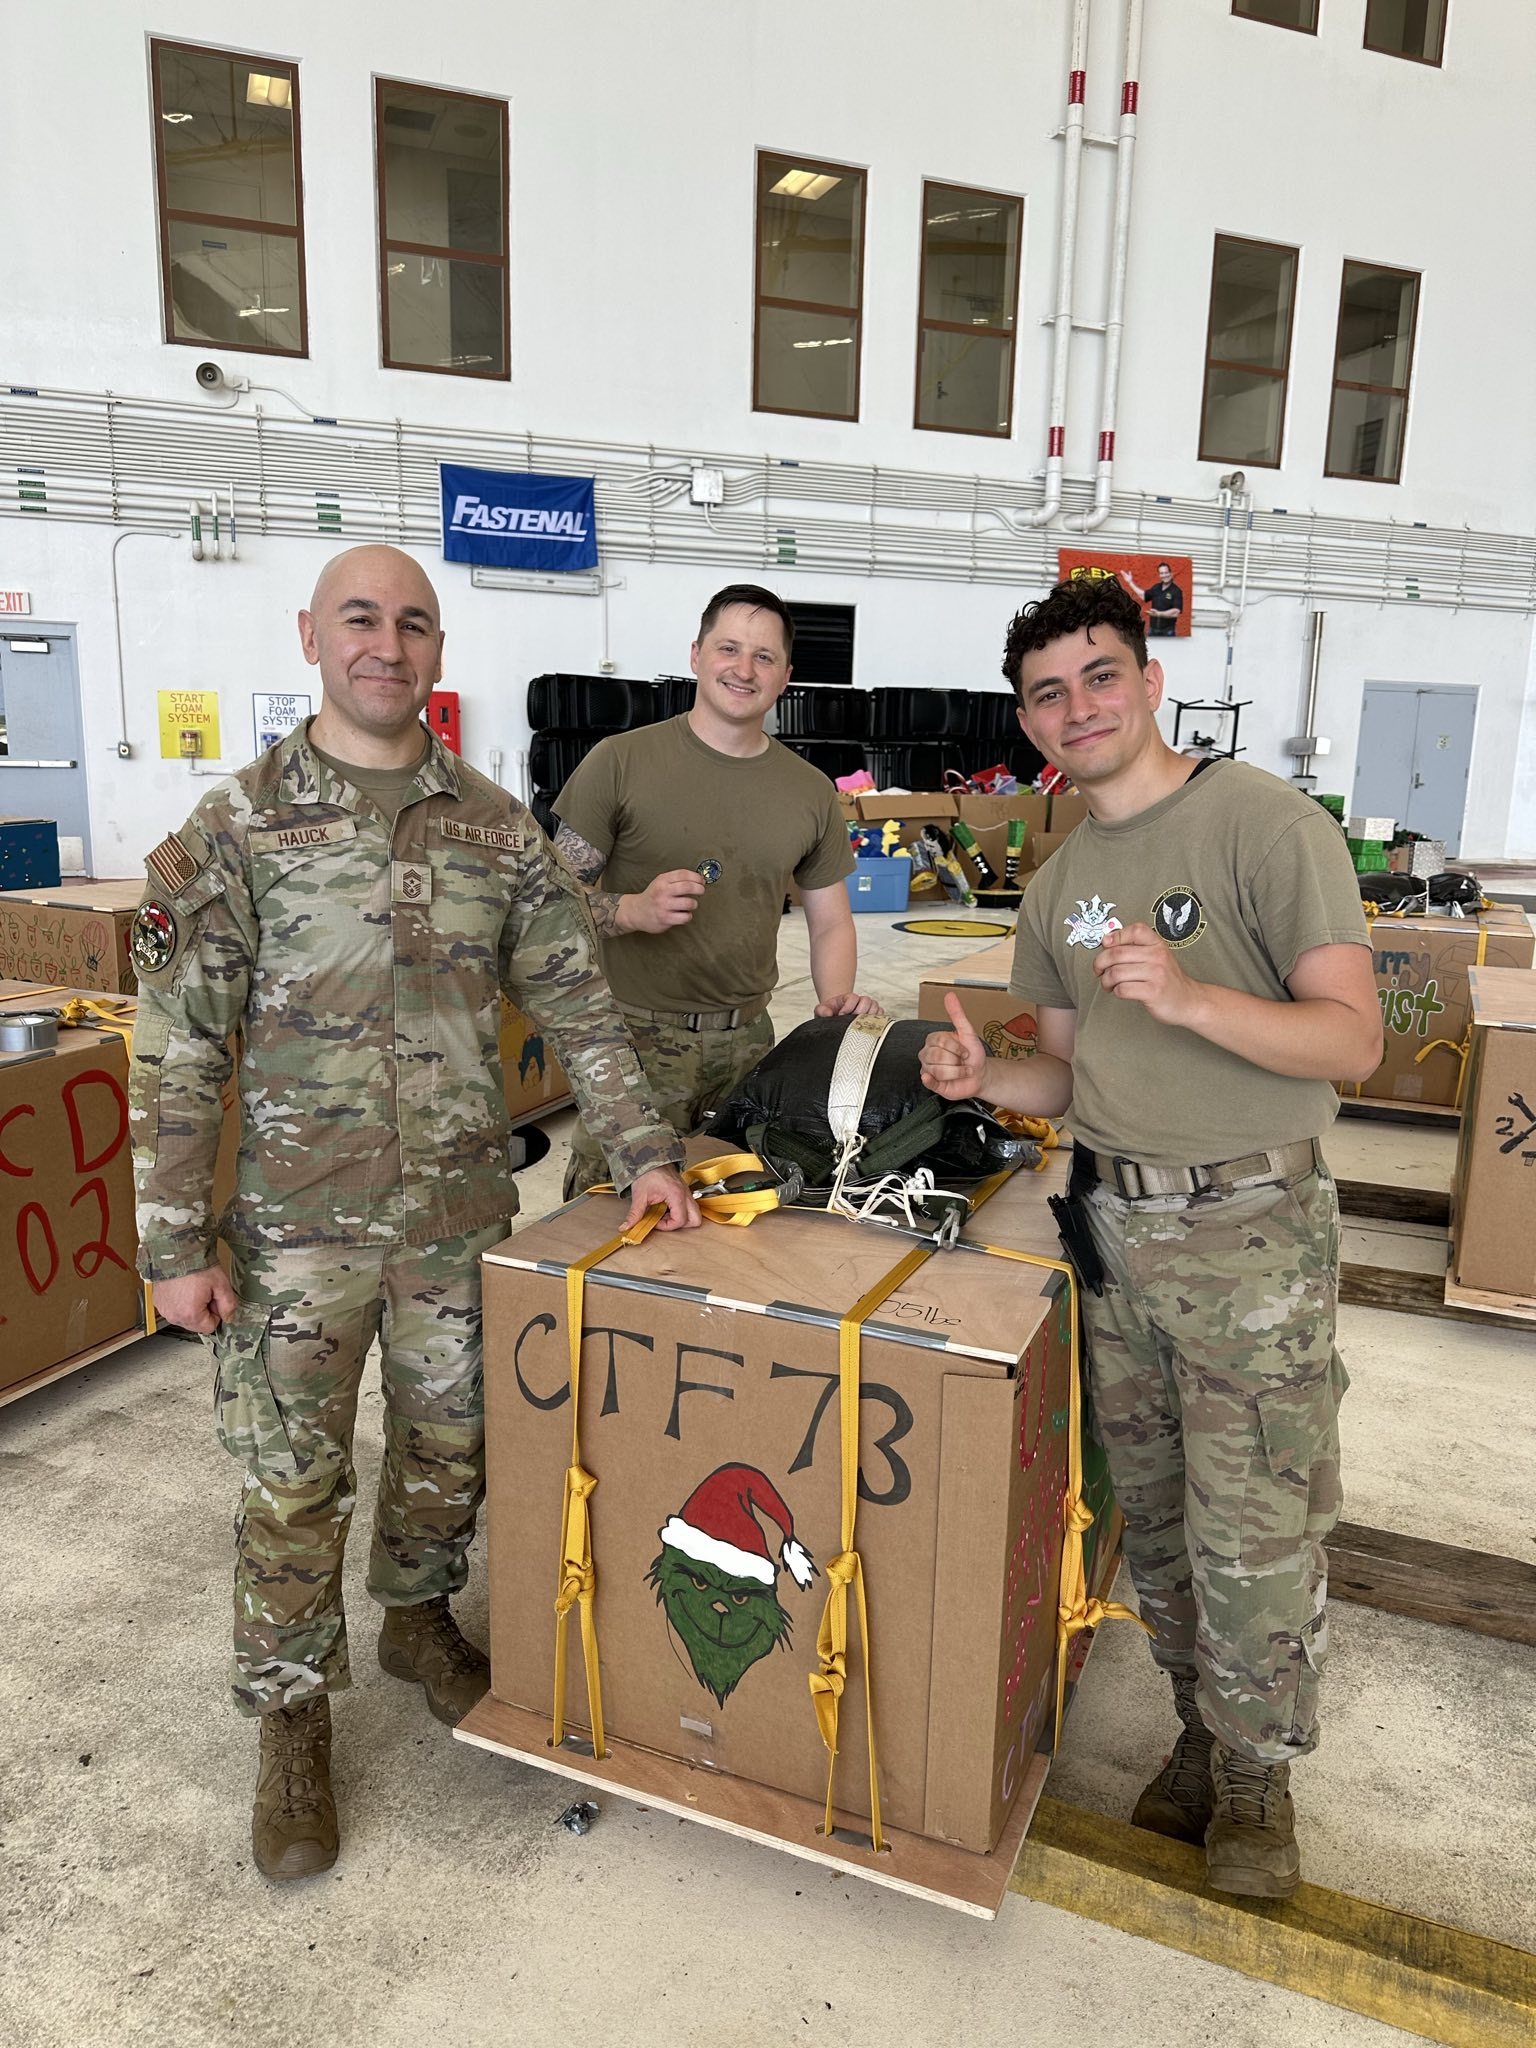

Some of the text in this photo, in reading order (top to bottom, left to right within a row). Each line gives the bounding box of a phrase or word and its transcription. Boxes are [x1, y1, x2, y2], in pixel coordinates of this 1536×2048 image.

[452, 495, 588, 535] FASTENAL
[0, 592, 23, 611] EXIT
[170, 693, 205, 703] START
[268, 696, 296, 706] STOP
[175, 703, 203, 713] FOAM
[269, 706, 296, 716] FOAM
[168, 713, 211, 723] SYSTEM
[277, 827, 330, 848] HAUCK
[444, 820, 520, 848] US AIR FORCE
[17, 1177, 131, 1296] 02
[514, 1312, 914, 1506] CTF 73
